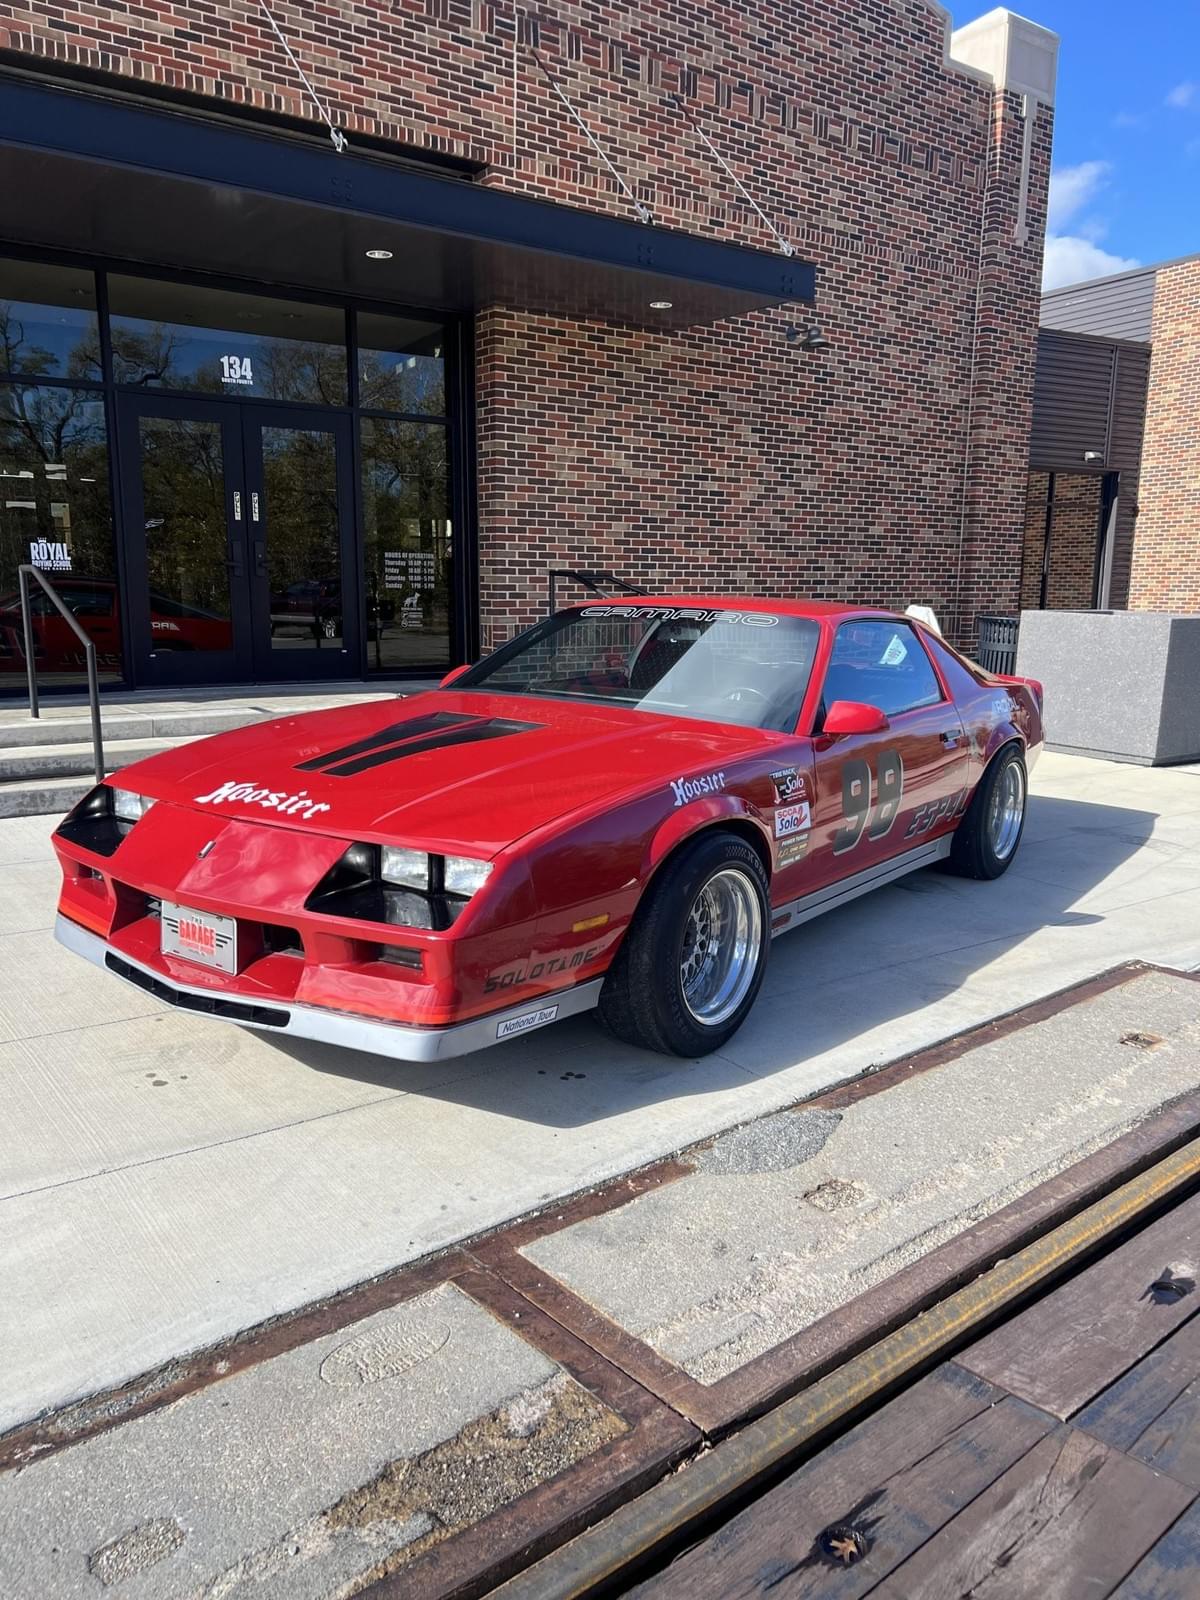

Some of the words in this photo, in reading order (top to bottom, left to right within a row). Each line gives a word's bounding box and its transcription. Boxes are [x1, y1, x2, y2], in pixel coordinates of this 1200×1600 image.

[220, 355, 253, 379] 134
[30, 542, 72, 560] ROYAL
[53, 560, 72, 568] SCHOOL
[580, 606, 779, 628] CAMARO
[669, 771, 726, 807] Hoosier
[785, 774, 804, 794] Solo
[192, 781, 331, 819] Hoosier
[832, 748, 904, 856] 98
[777, 807, 797, 819] SCCA
[779, 814, 798, 831] Solo
[179, 919, 215, 948] GARAGE
[502, 1012, 537, 1034] National
[536, 1009, 555, 1023] Tour
